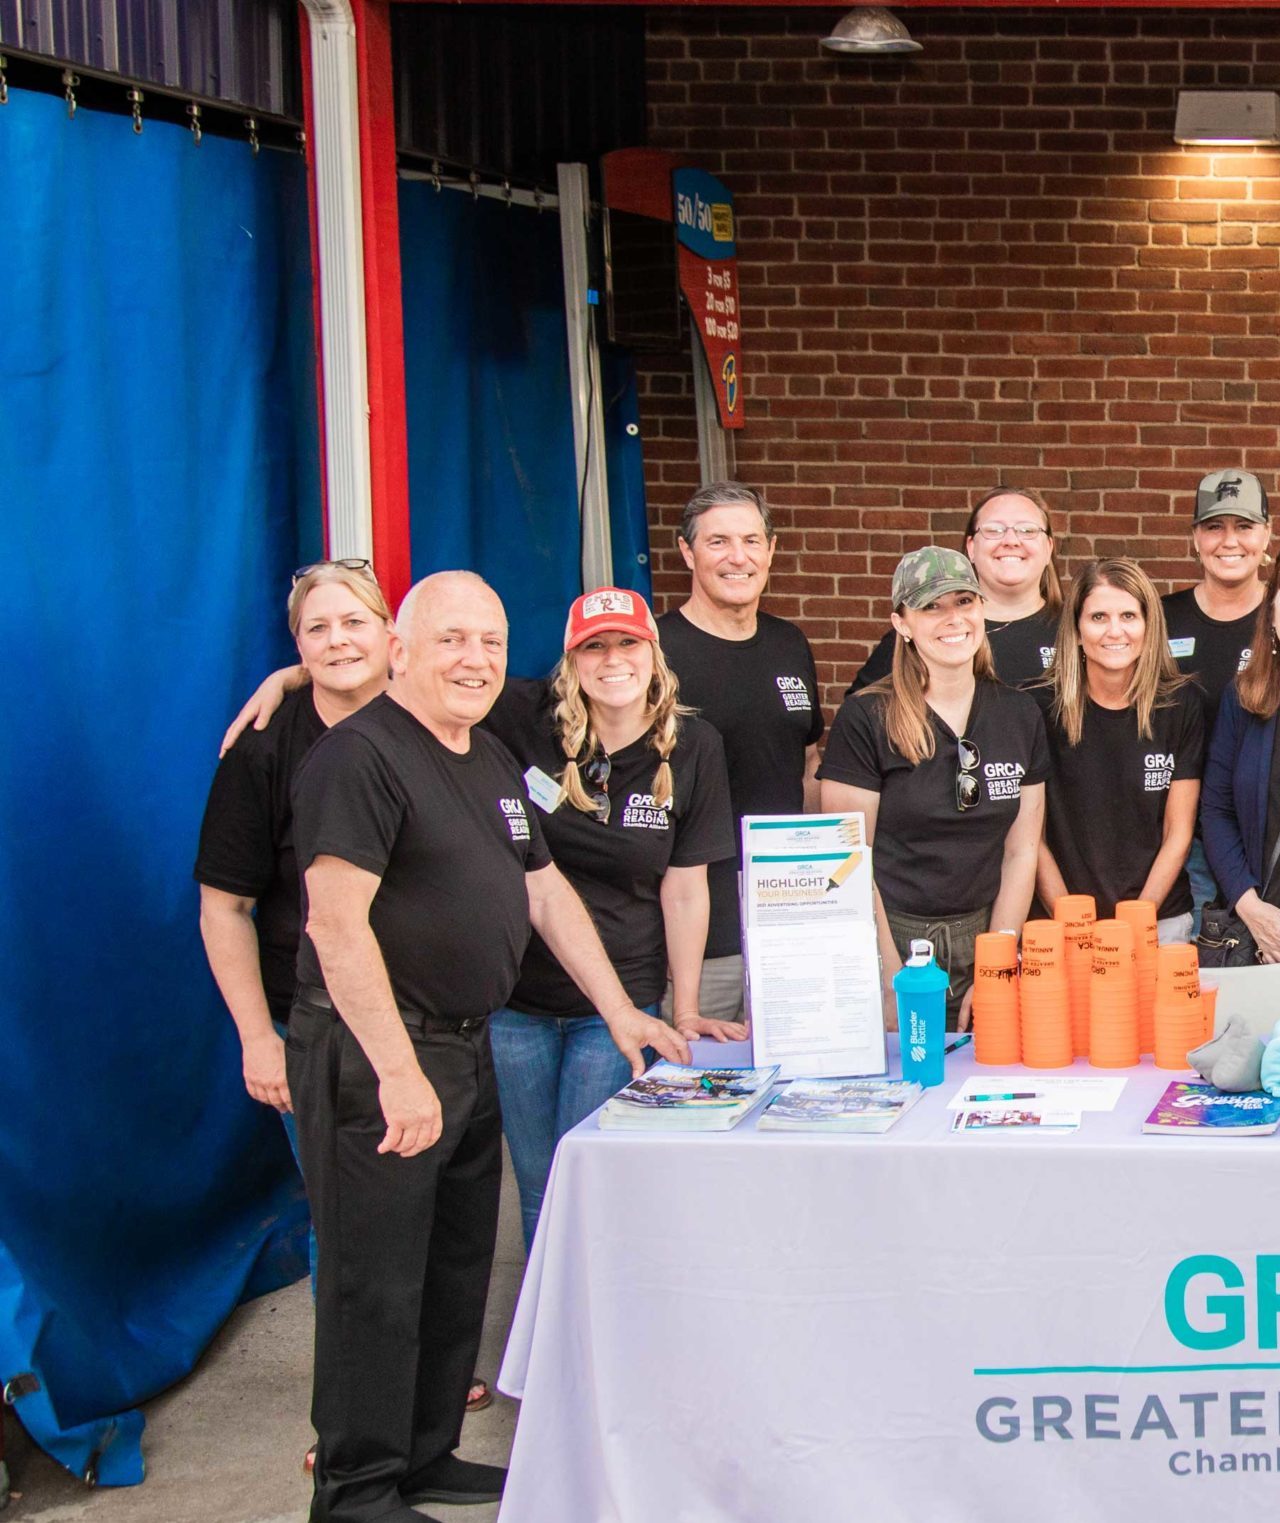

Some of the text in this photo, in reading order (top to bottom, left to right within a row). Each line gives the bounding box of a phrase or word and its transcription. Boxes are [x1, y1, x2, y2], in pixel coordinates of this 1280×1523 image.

[677, 192, 712, 232] 50/50
[776, 676, 807, 690] GRCA
[984, 762, 1026, 778] GRCA
[499, 798, 525, 815] GRCA
[757, 876, 825, 889] HIGHLIGHT
[757, 888, 824, 898] YOUR BUSINESS
[910, 1010, 918, 1044] Blender
[918, 1019, 926, 1044] Bottle
